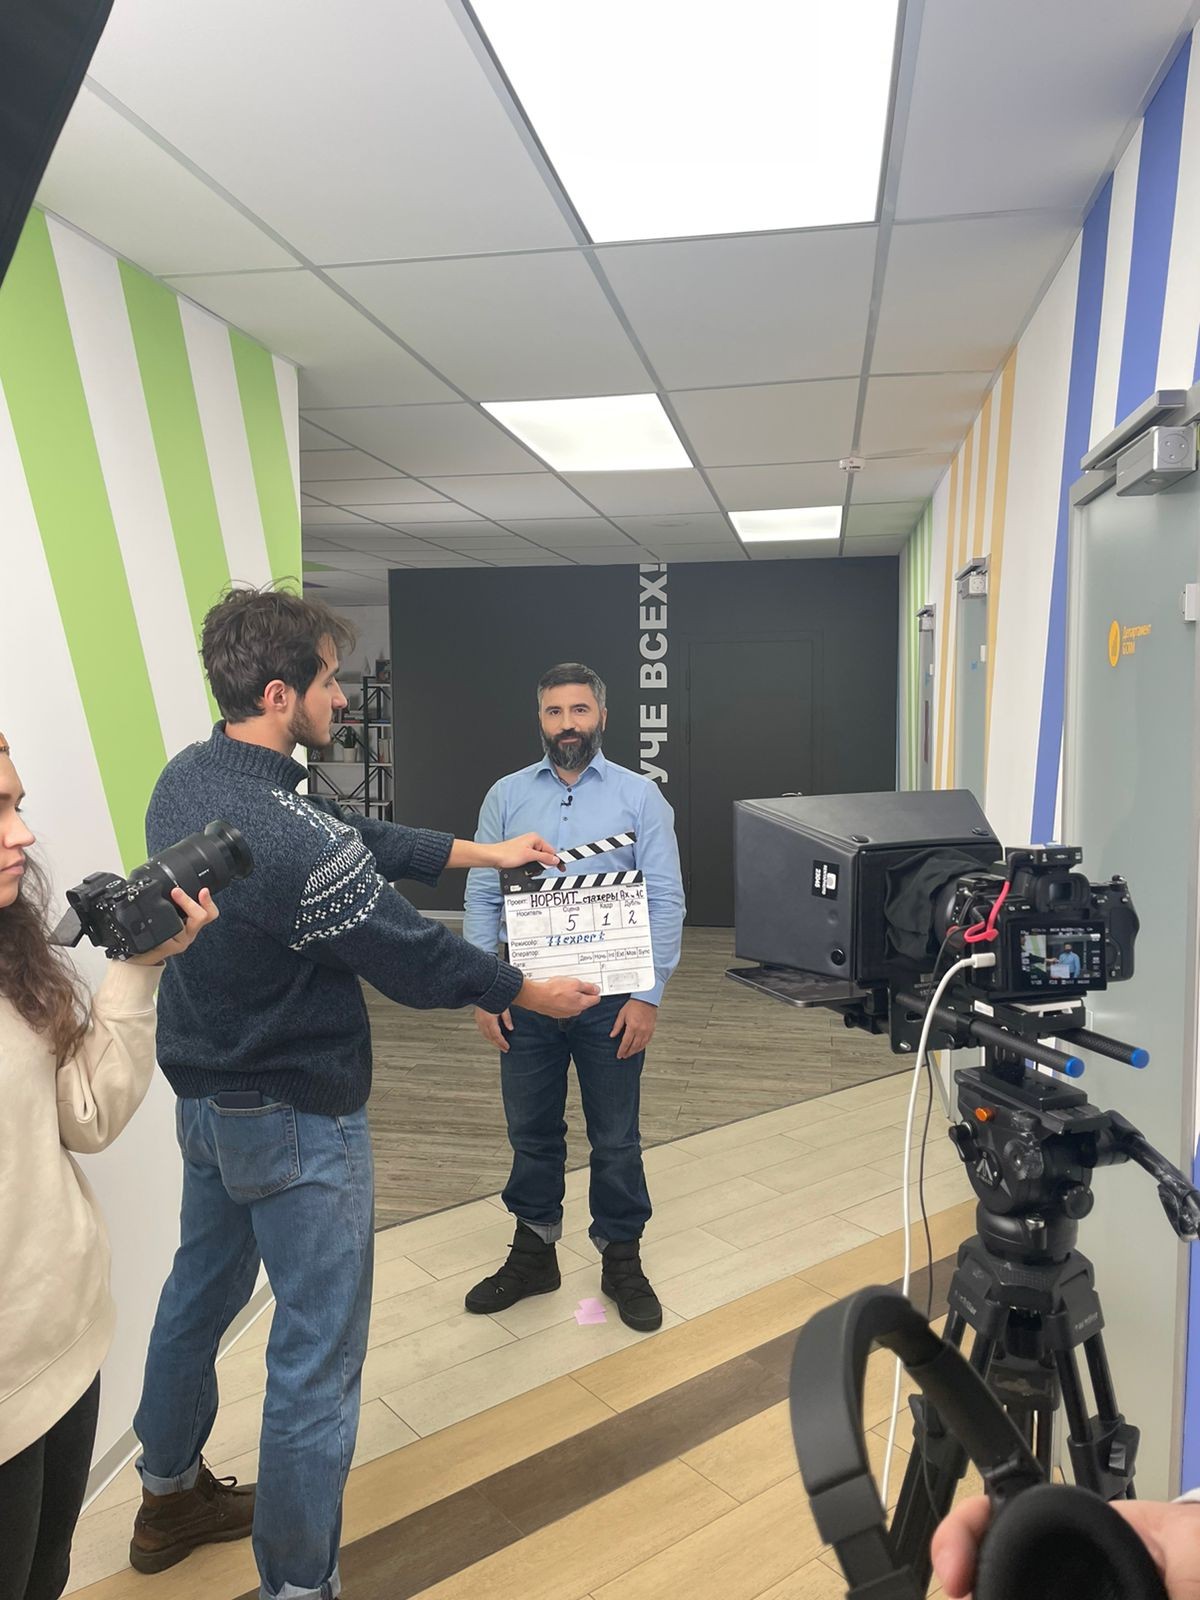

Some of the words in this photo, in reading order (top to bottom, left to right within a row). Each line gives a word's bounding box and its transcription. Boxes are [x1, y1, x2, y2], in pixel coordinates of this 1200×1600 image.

[639, 563, 668, 688] ВСЕХ!
[566, 914, 580, 931] 5
[602, 912, 611, 927] 1
[628, 909, 637, 925] 2
